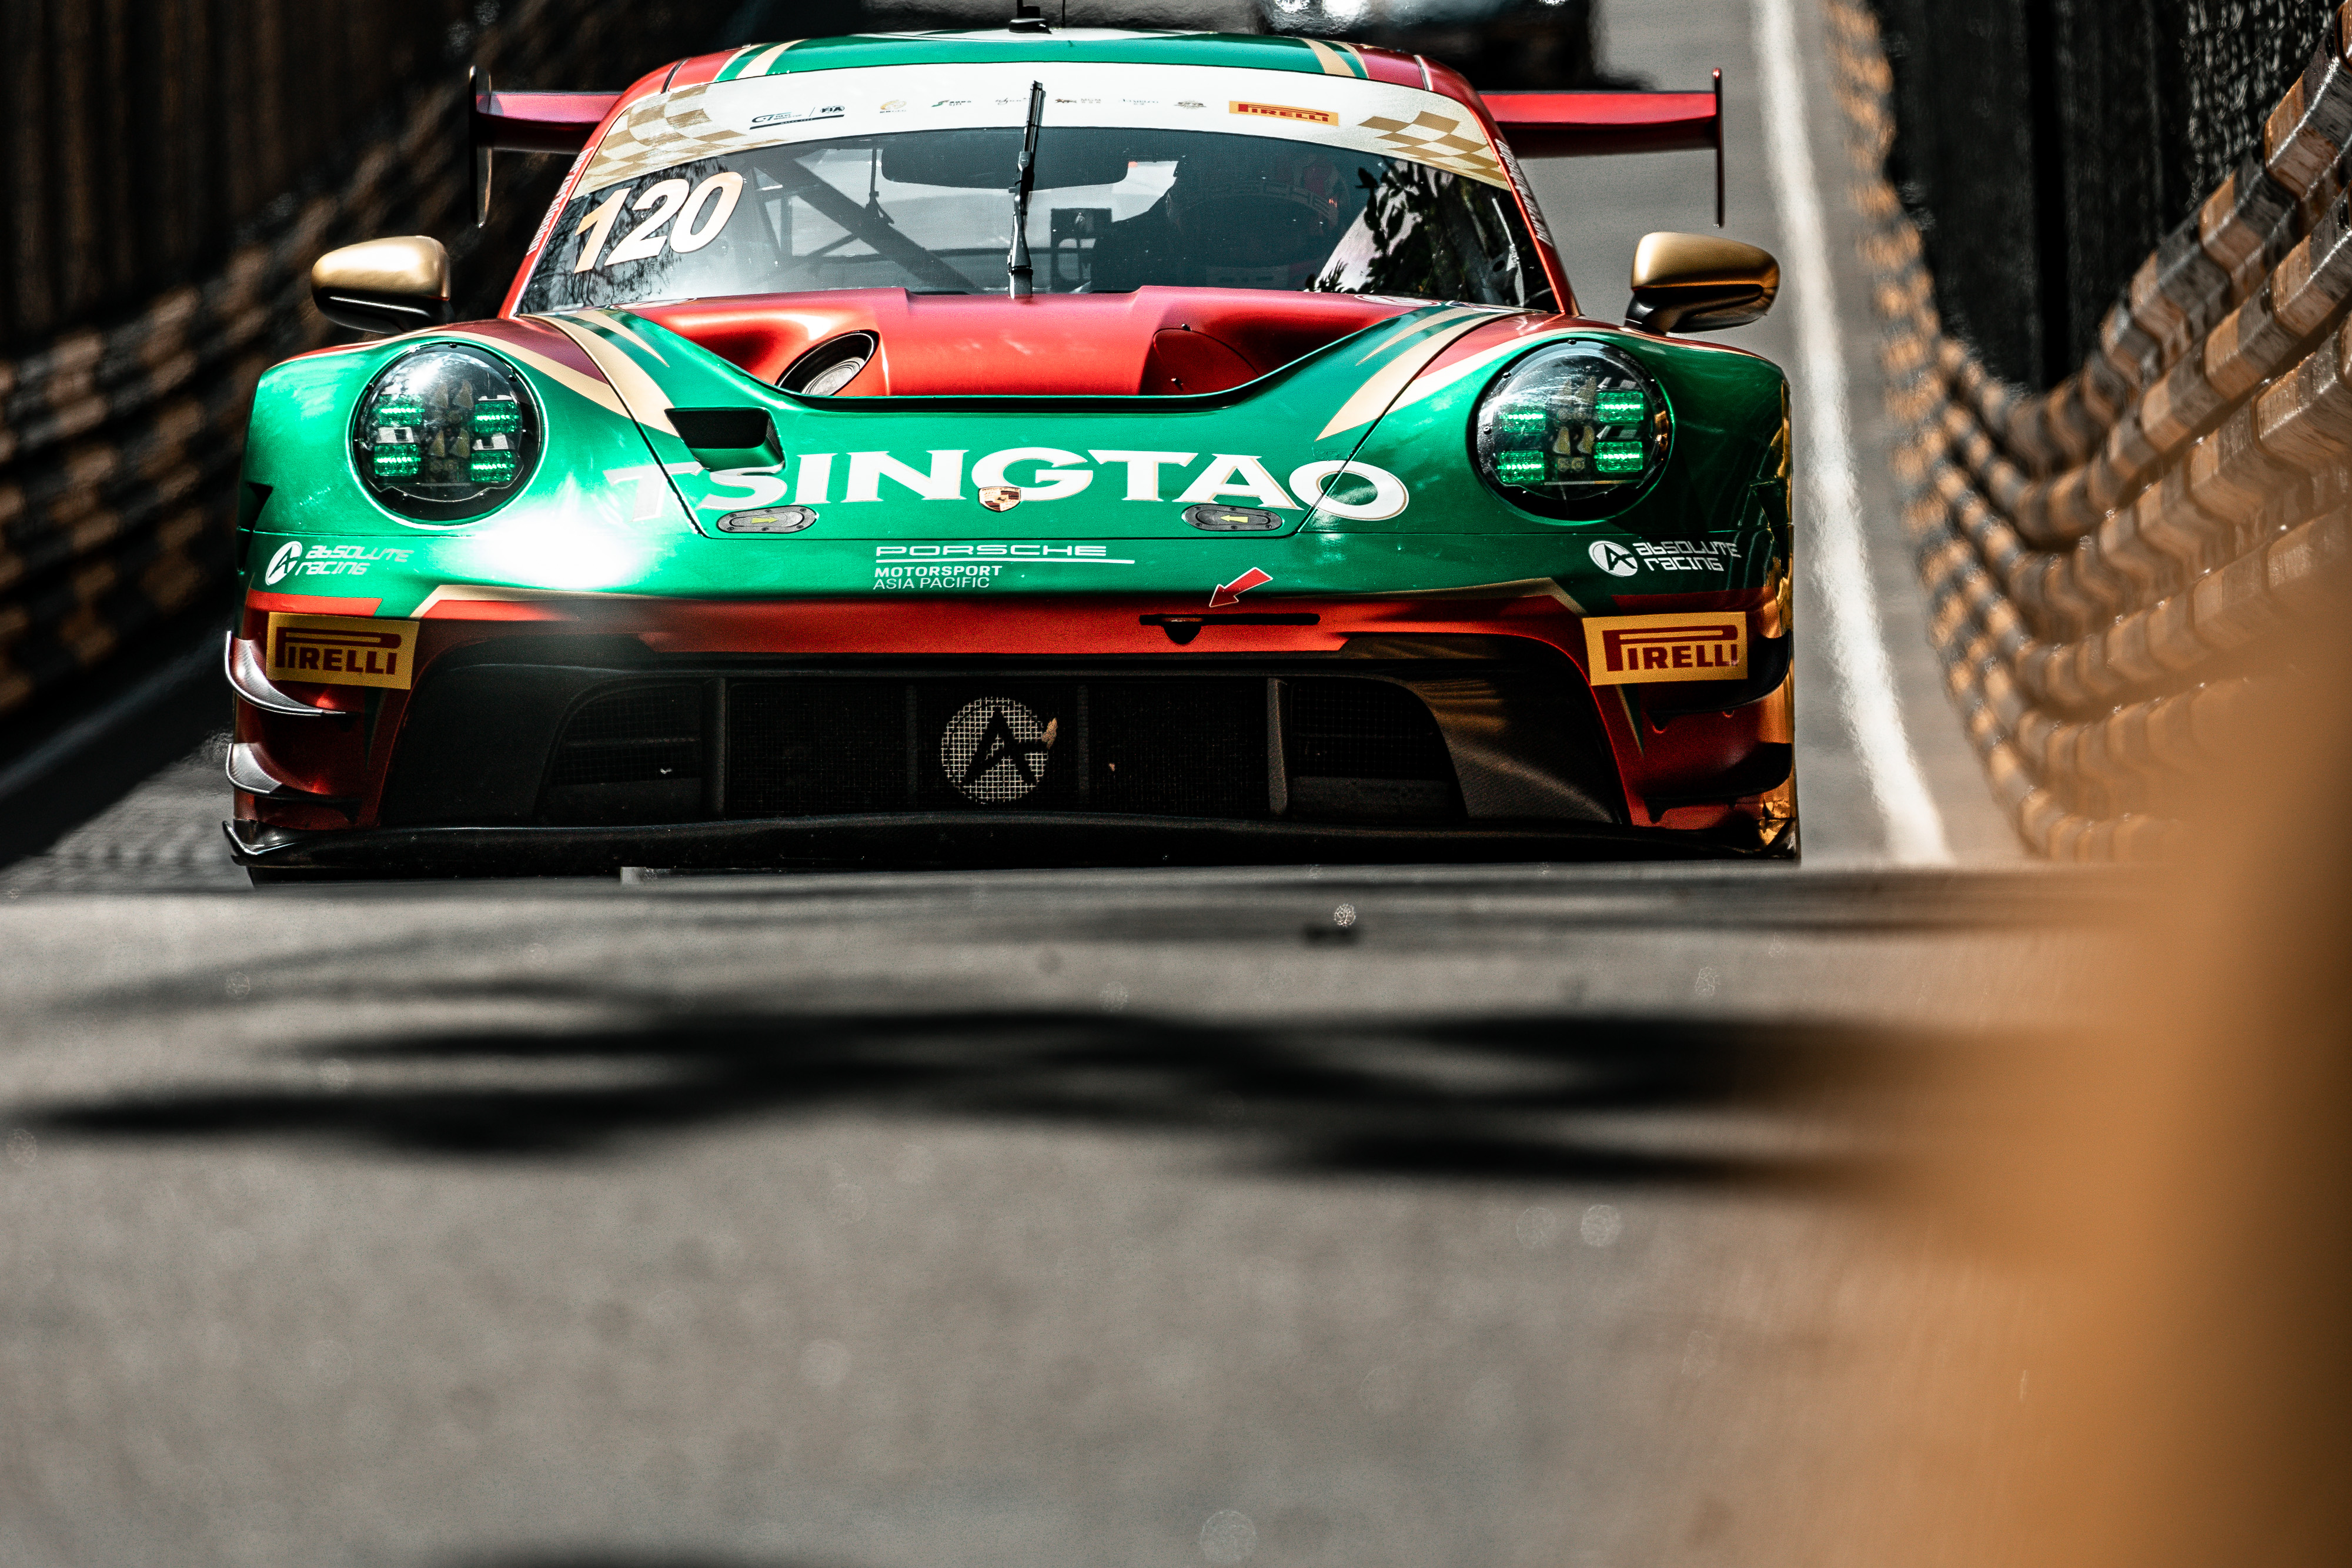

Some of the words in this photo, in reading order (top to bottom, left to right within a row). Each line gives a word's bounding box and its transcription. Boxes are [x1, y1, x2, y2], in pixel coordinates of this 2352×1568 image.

[1238, 103, 1329, 122] PIRELLI
[573, 171, 744, 274] 120
[603, 447, 1409, 523] TSINGTAO
[876, 544, 1107, 557] PORSCHE
[873, 577, 915, 590] ASIA
[919, 576, 990, 589] PACIFIC
[874, 566, 1003, 577] MOTORSPORT
[275, 626, 402, 675] PIRELLI
[1602, 624, 1739, 672] PIRELLI
